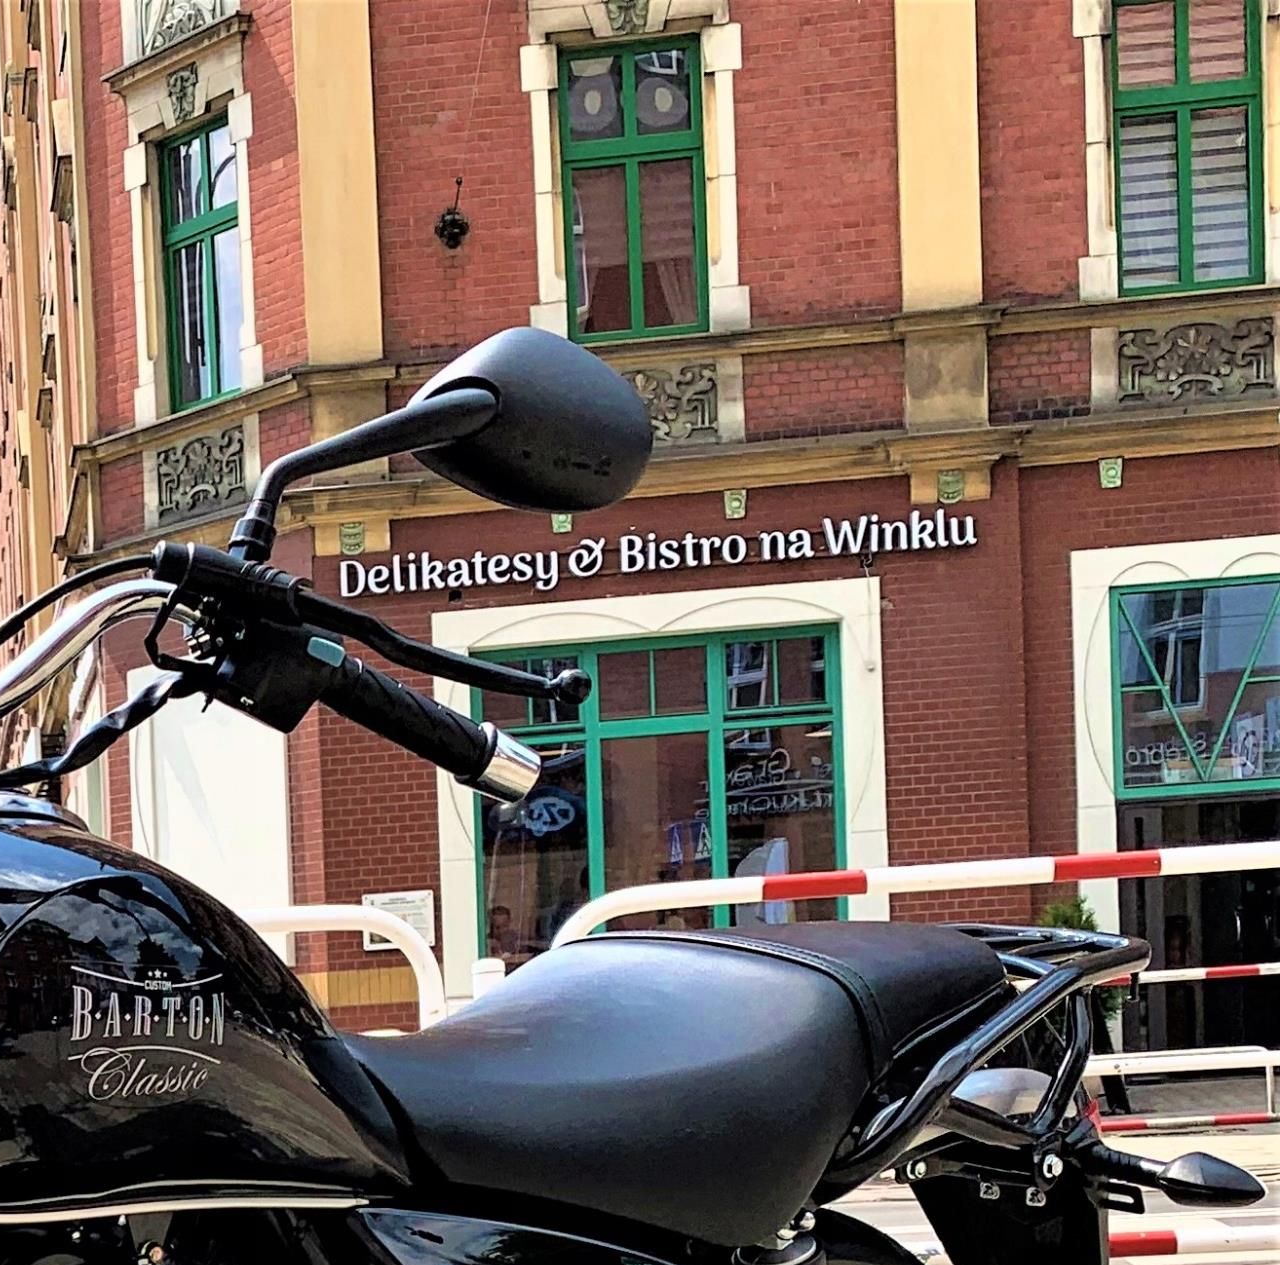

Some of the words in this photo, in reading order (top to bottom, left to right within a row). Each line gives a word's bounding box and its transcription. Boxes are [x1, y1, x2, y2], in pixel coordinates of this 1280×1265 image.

[339, 550, 559, 597] Delikatesy
[569, 537, 606, 577] &
[619, 530, 747, 573] Bistro
[759, 528, 815, 561] na
[822, 507, 978, 556] Winklu
[144, 980, 172, 991] CUSTOM
[81, 1047, 209, 1101] Classic
